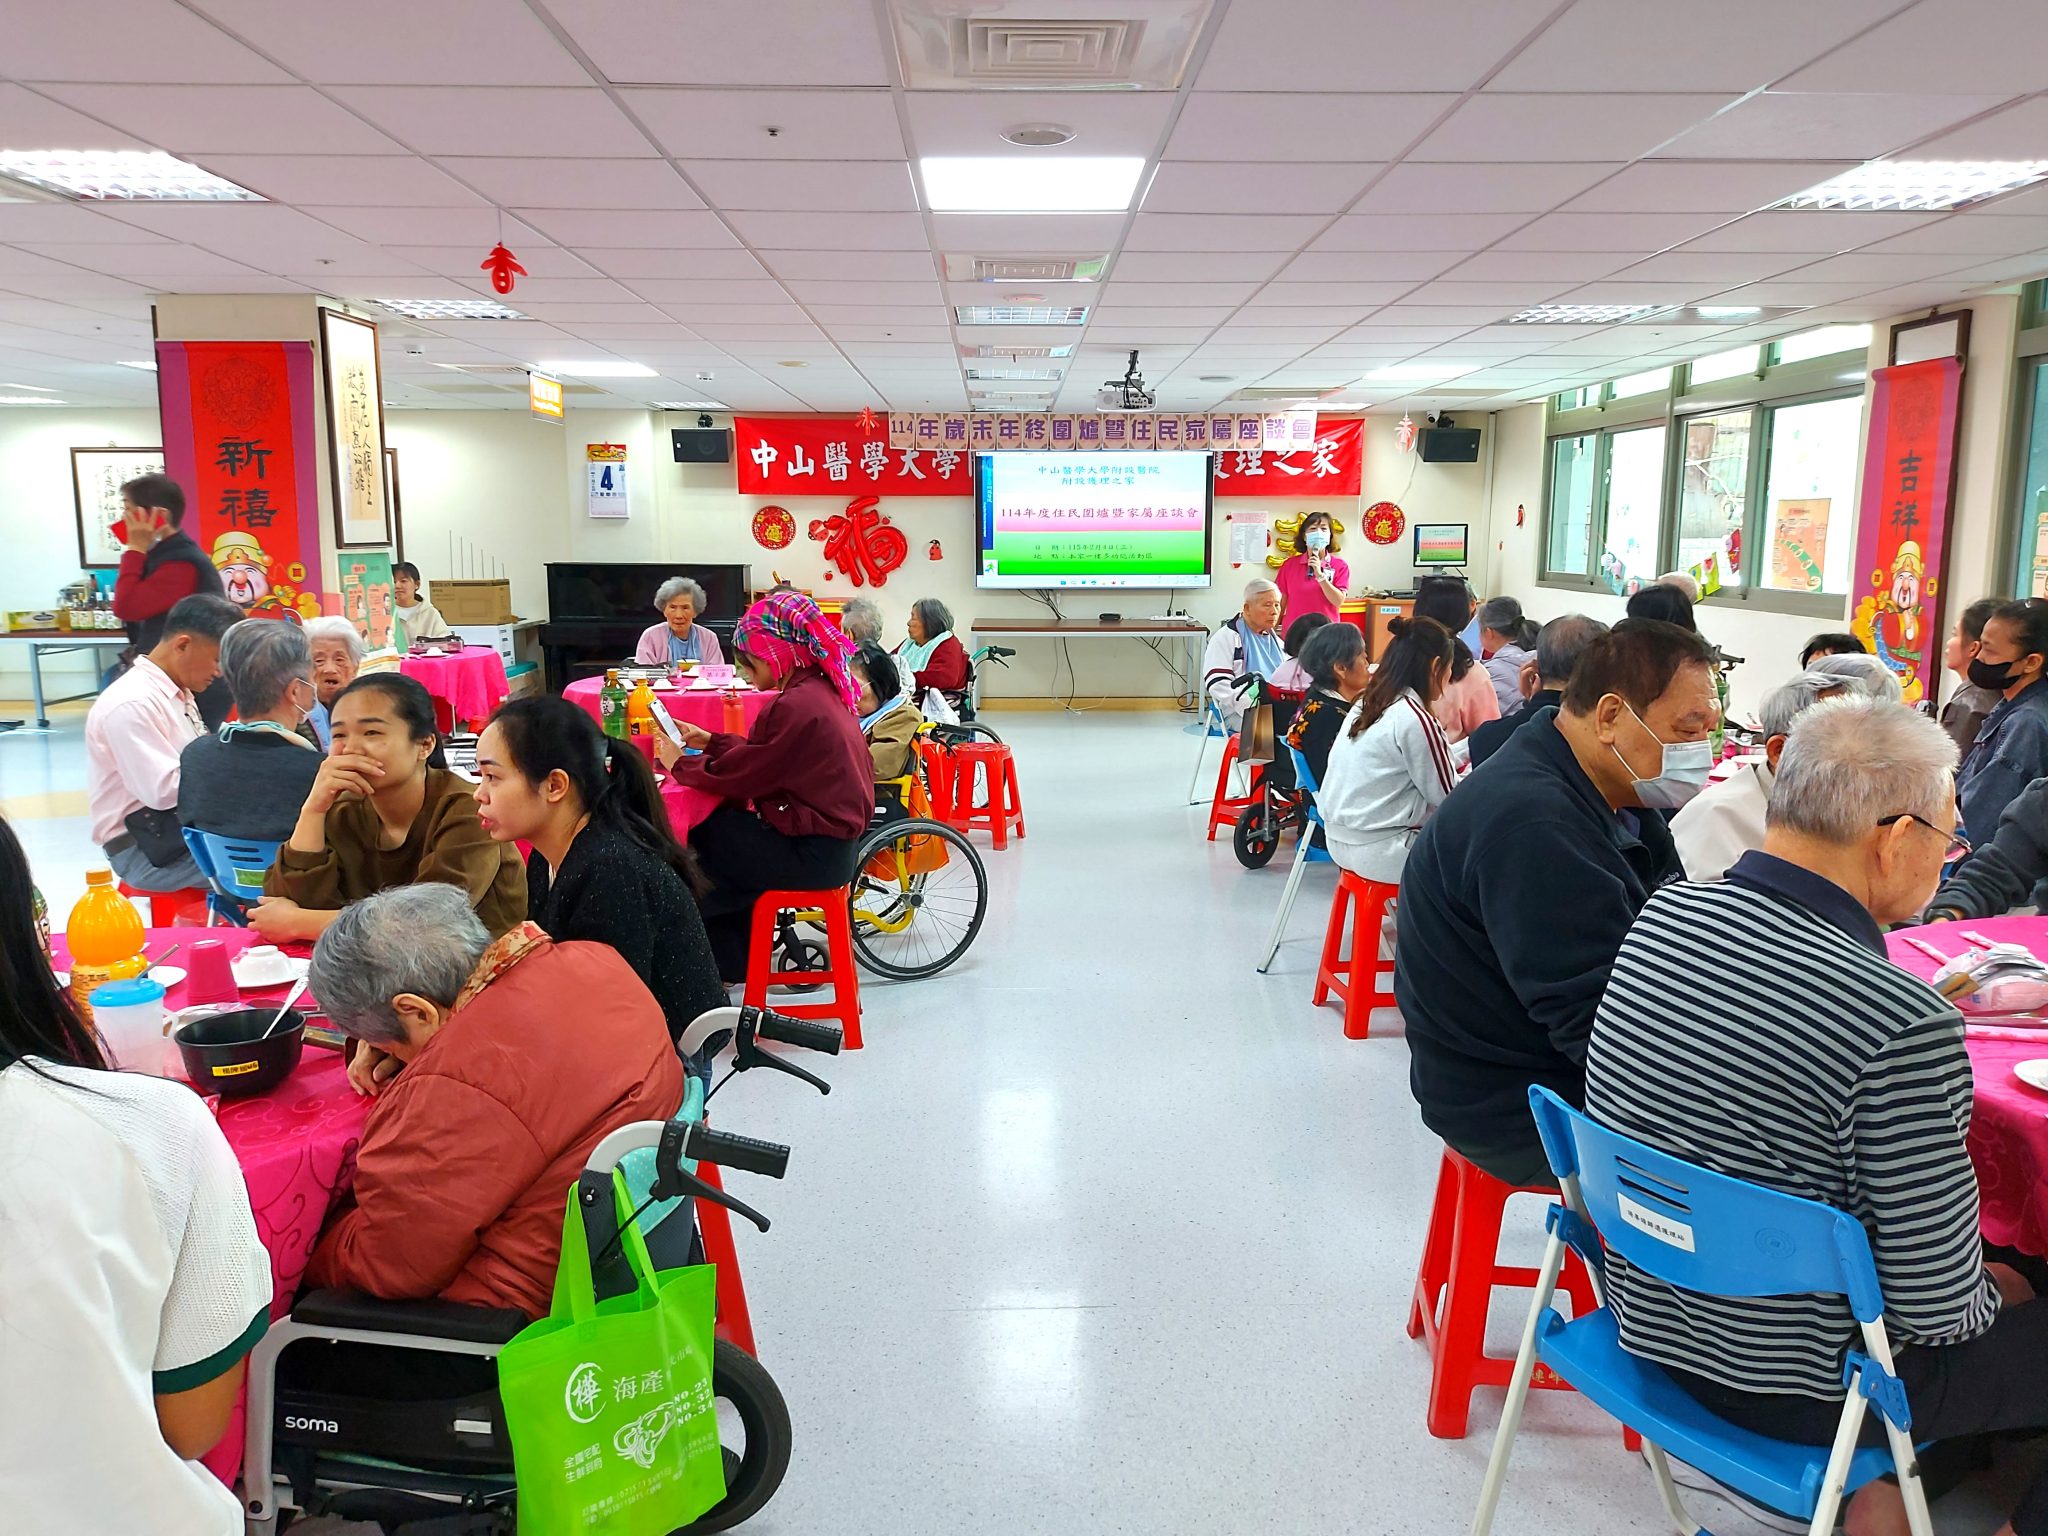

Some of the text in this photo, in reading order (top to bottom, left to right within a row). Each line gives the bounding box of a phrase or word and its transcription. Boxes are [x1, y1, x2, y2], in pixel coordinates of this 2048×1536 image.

[750, 438, 974, 482] 中山醫學大學
[1038, 465, 1161, 475] 中山醫學大學附設醫院
[214, 436, 280, 528] 新禧
[600, 465, 614, 491] 4
[1061, 476, 1136, 486] 附設護理之家
[1890, 449, 1924, 541] 吉祥
[1000, 507, 1199, 519] 114年度住民圍爐暨家屬座談會
[613, 1369, 664, 1403] 海產
[285, 1416, 339, 1433] soma
